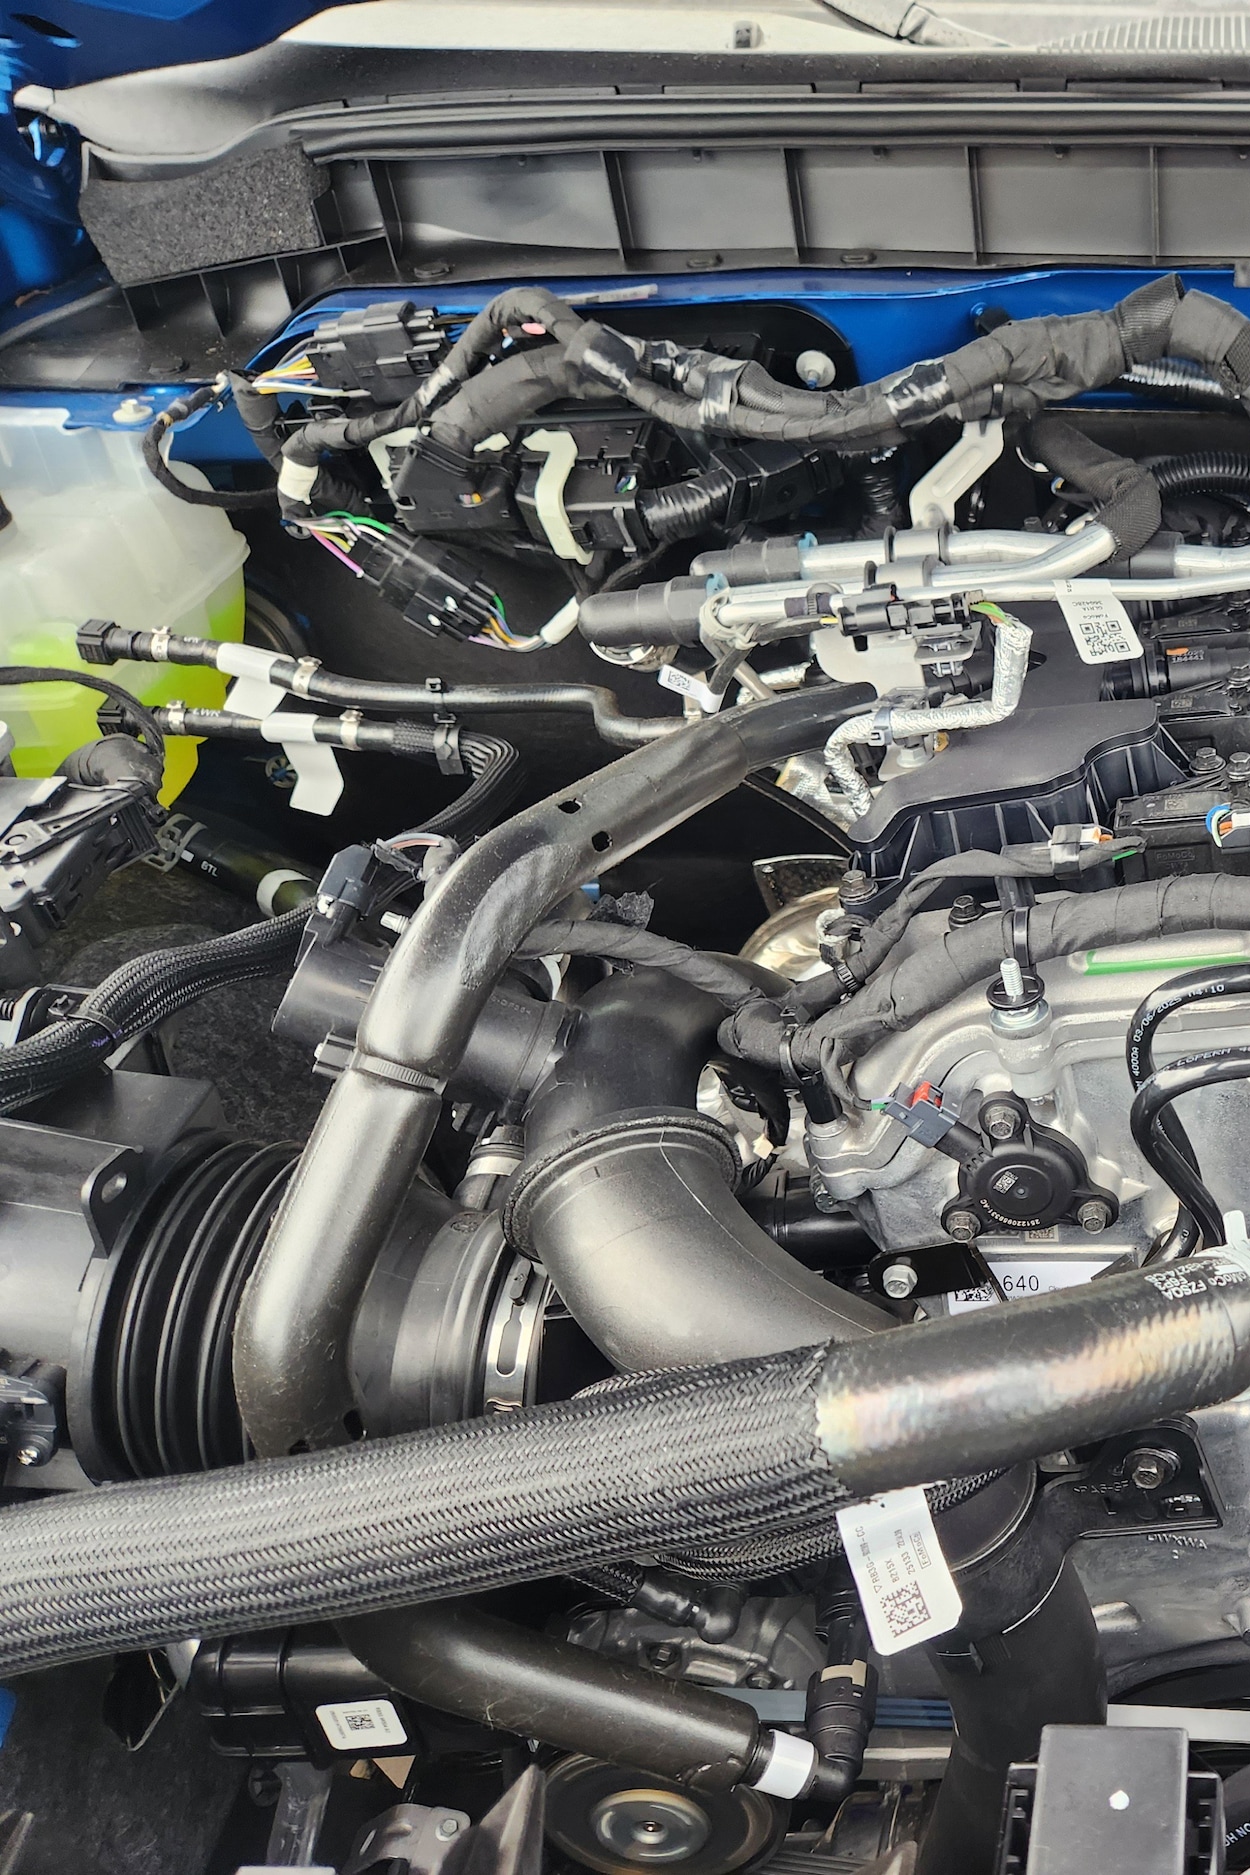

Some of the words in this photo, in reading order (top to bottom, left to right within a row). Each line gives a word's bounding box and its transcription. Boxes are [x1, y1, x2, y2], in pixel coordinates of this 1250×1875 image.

[1133, 995, 1183, 1043] 03/06/2025
[1002, 1274, 1040, 1292] 640
[1206, 1271, 1248, 1287] oMoCo
